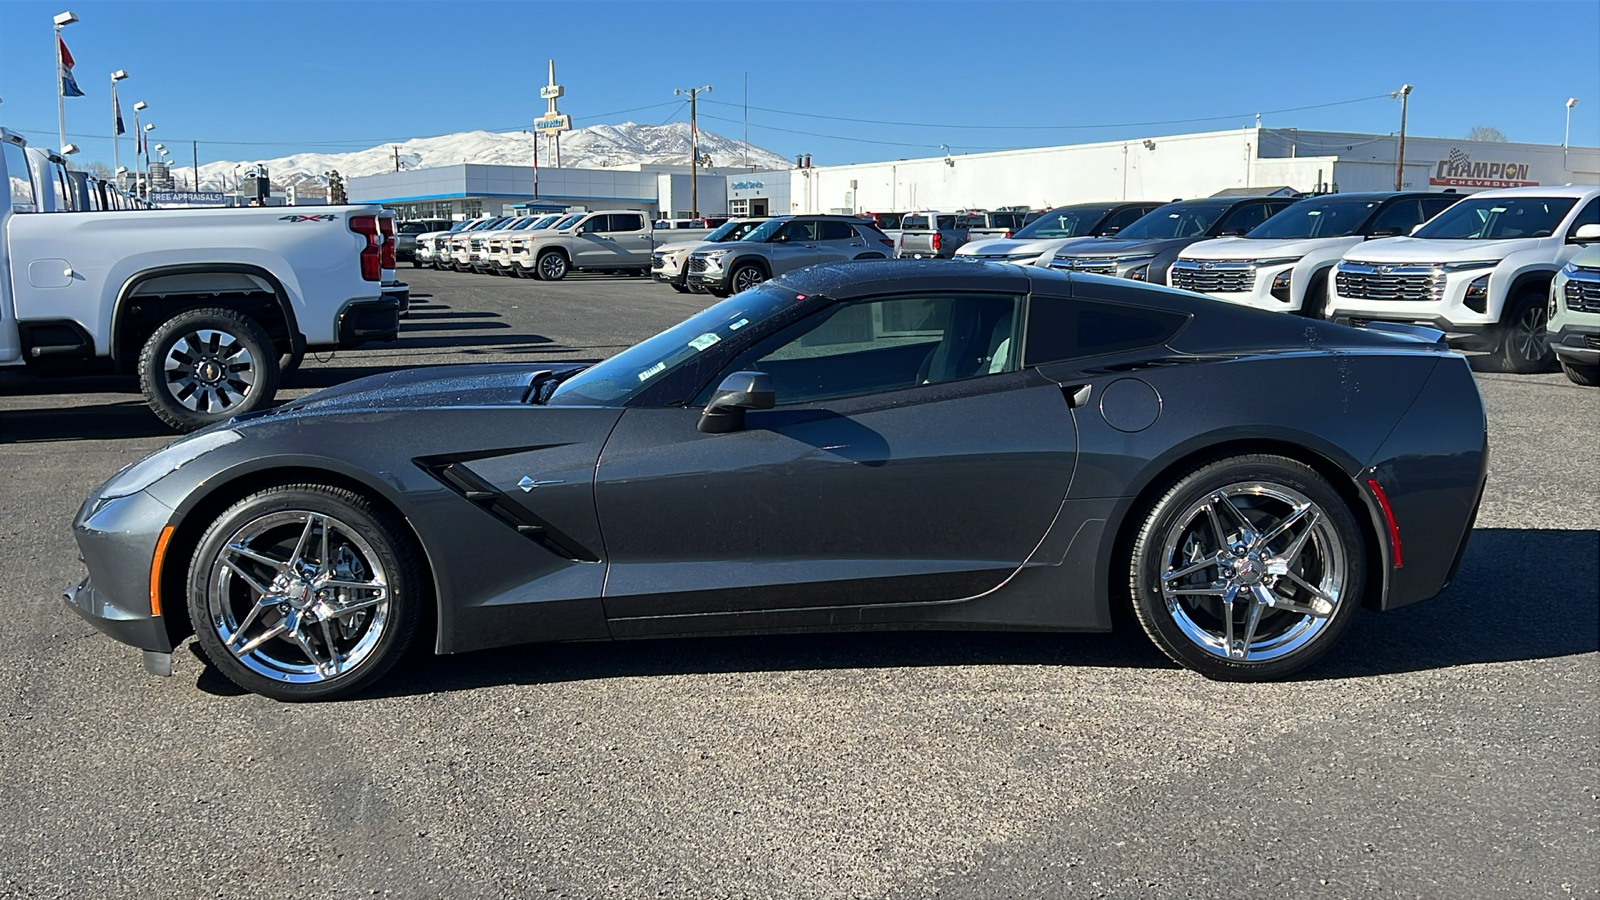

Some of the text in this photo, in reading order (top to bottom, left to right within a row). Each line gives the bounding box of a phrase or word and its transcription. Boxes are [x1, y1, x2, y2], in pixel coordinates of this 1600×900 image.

[1436, 160, 1529, 181] CHAMPION
[1450, 179, 1524, 187] CHEVROLET
[152, 193, 172, 201] FREE
